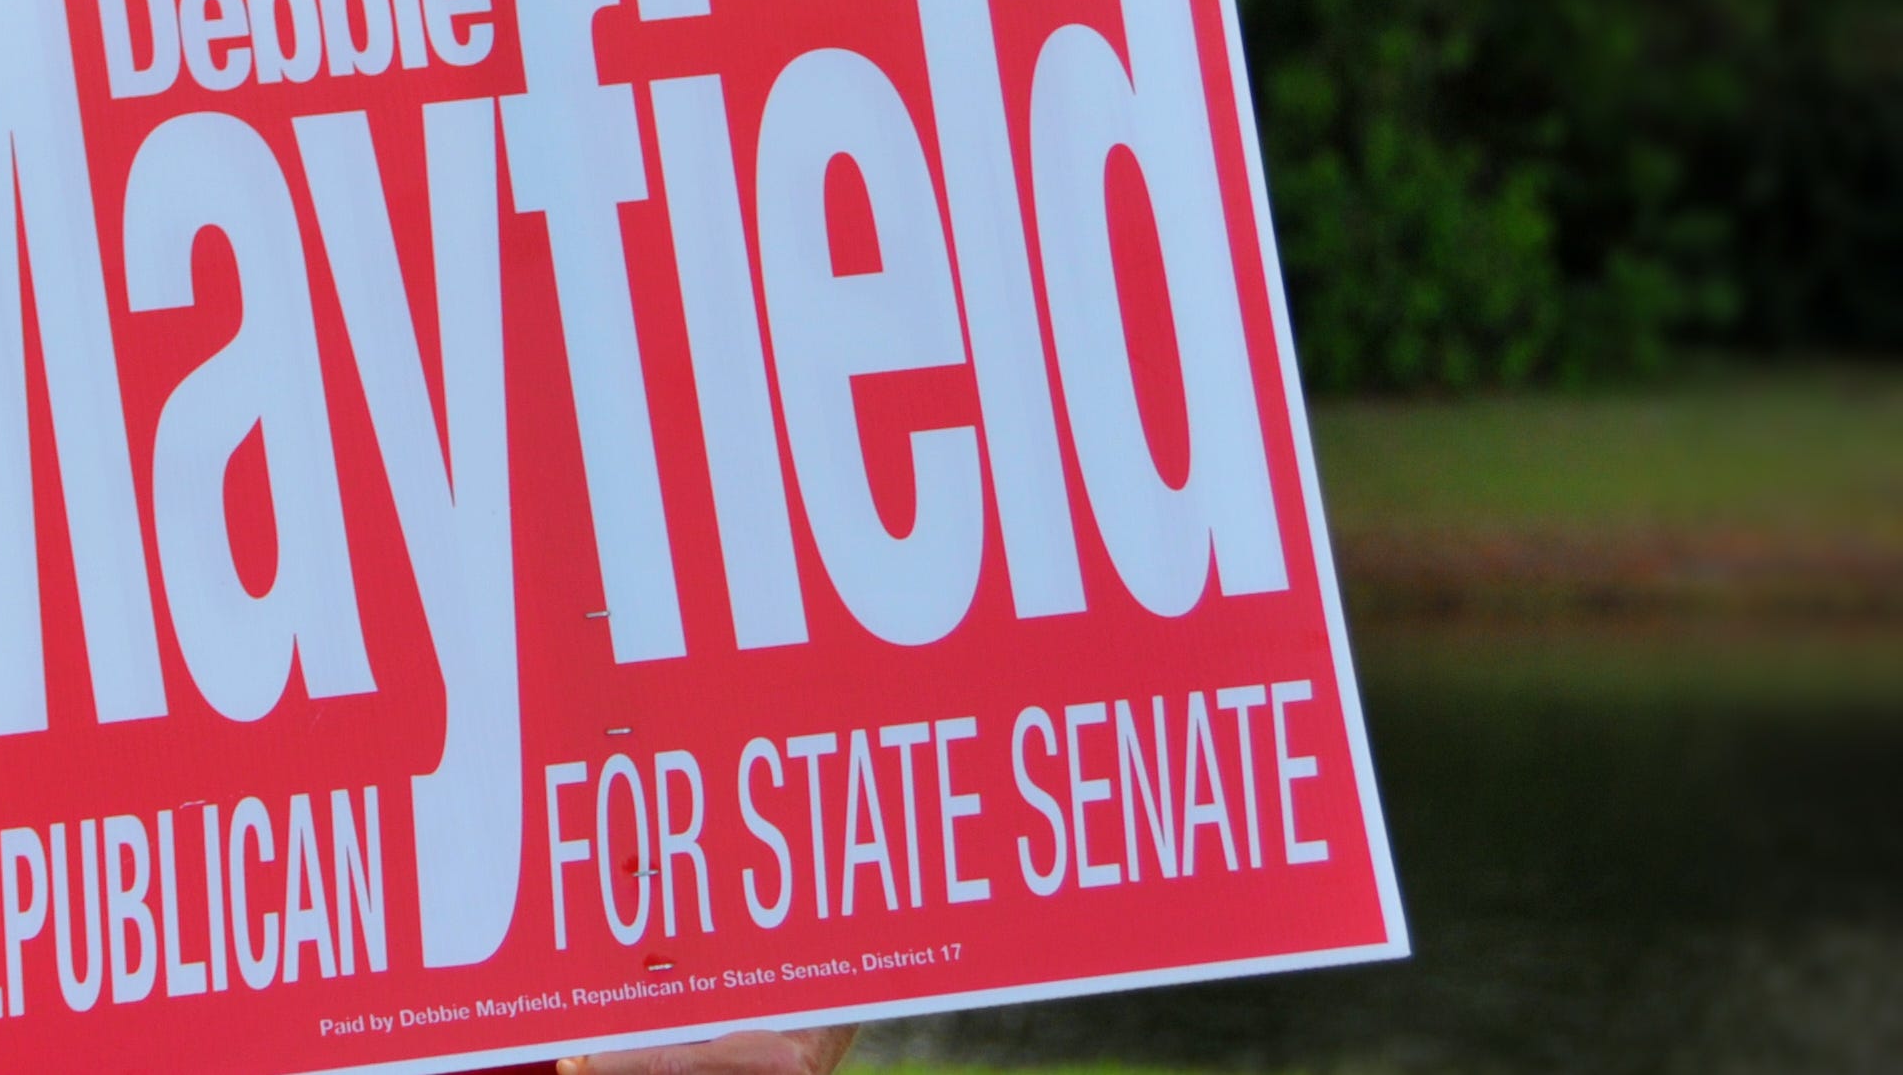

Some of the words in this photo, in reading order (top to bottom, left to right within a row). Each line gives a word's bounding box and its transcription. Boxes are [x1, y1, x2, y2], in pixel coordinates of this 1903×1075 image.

[544, 749, 714, 950] FOR
[736, 716, 991, 929] STATE
[1010, 679, 1329, 896] SENATE
[319, 1014, 365, 1036] Paid
[370, 1013, 394, 1035] by
[399, 1004, 470, 1028] Debbie
[476, 992, 568, 1019] Mayfield,
[572, 978, 684, 1007] Republican
[688, 975, 717, 992] for
[723, 968, 776, 988] State
[781, 958, 859, 981] Senate,
[862, 947, 936, 972] District
[940, 943, 964, 961] 17
